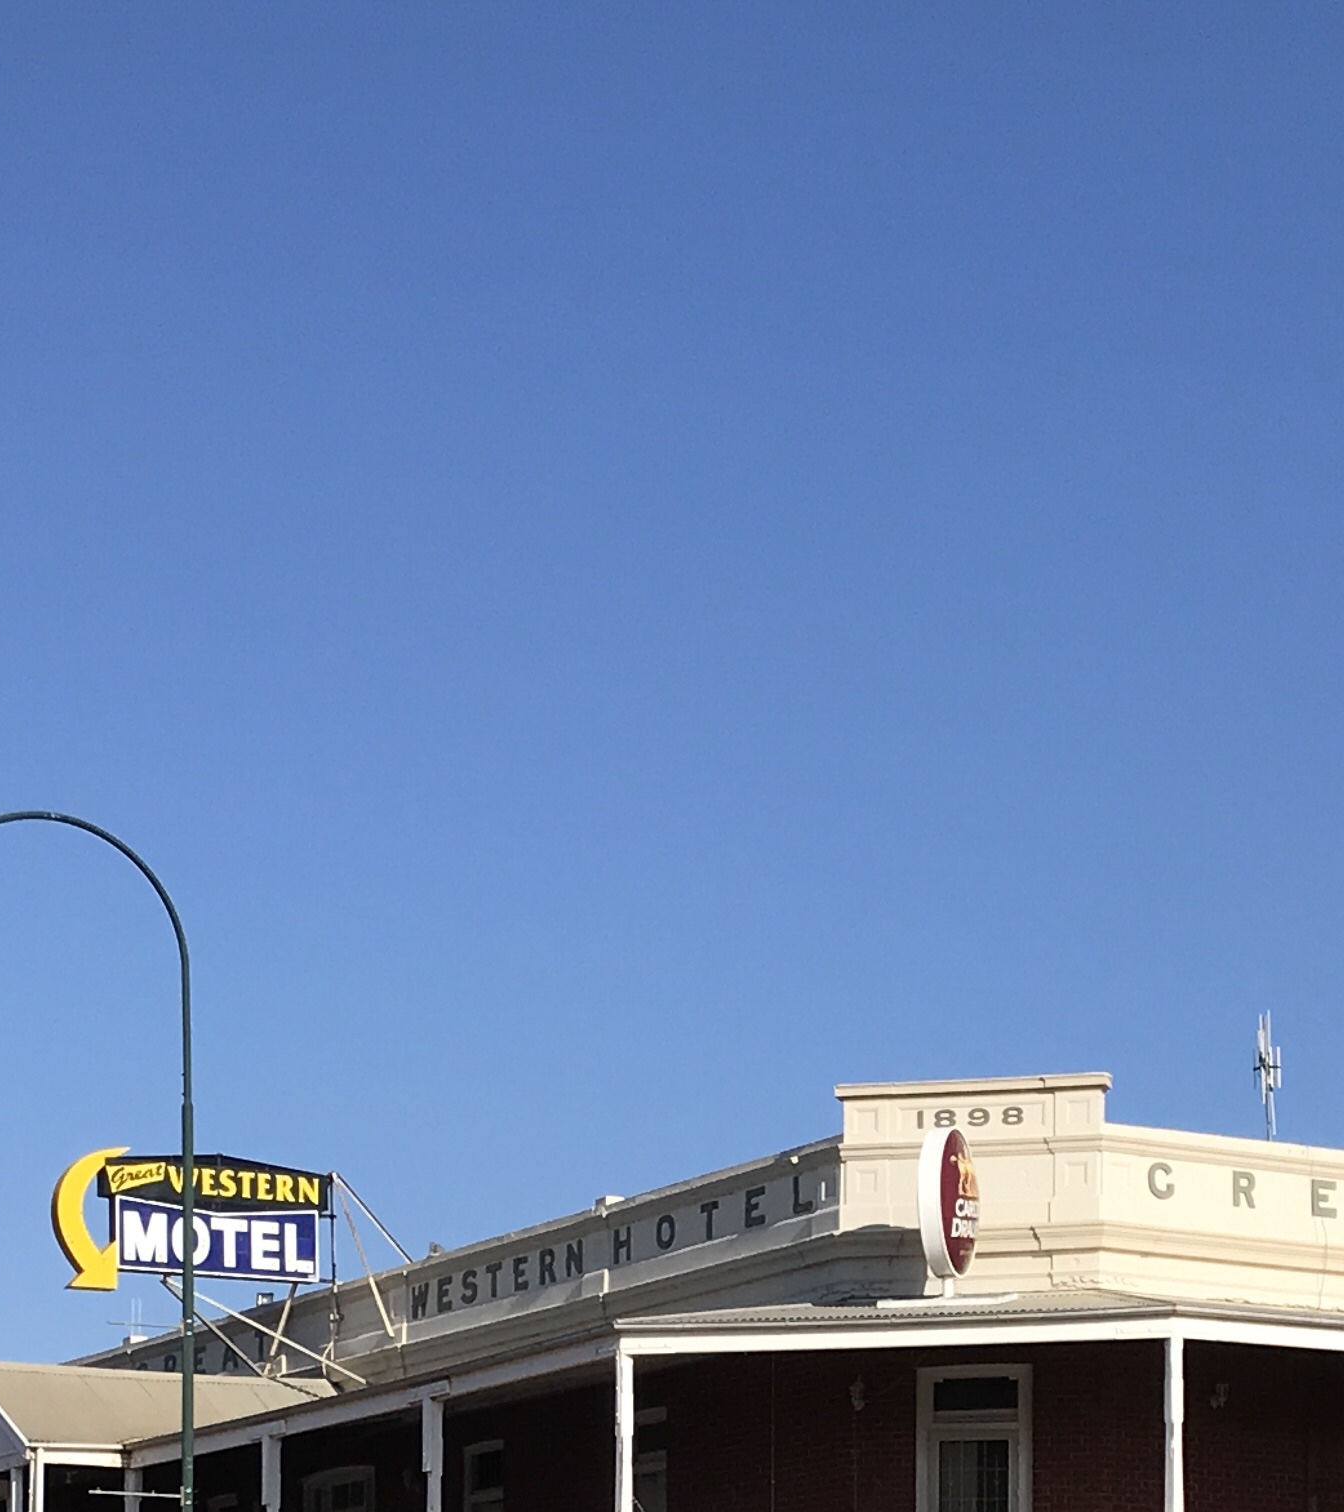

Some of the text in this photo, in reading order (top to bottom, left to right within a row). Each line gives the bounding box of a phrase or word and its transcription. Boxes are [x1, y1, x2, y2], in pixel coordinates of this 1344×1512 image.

[917, 1106, 1024, 1129] 1898
[111, 1164, 320, 1205] Great WESTERN
[122, 1210, 314, 1274] MOTEL
[411, 1239, 584, 1319] WESTERN
[613, 1176, 814, 1264] HOTEL
